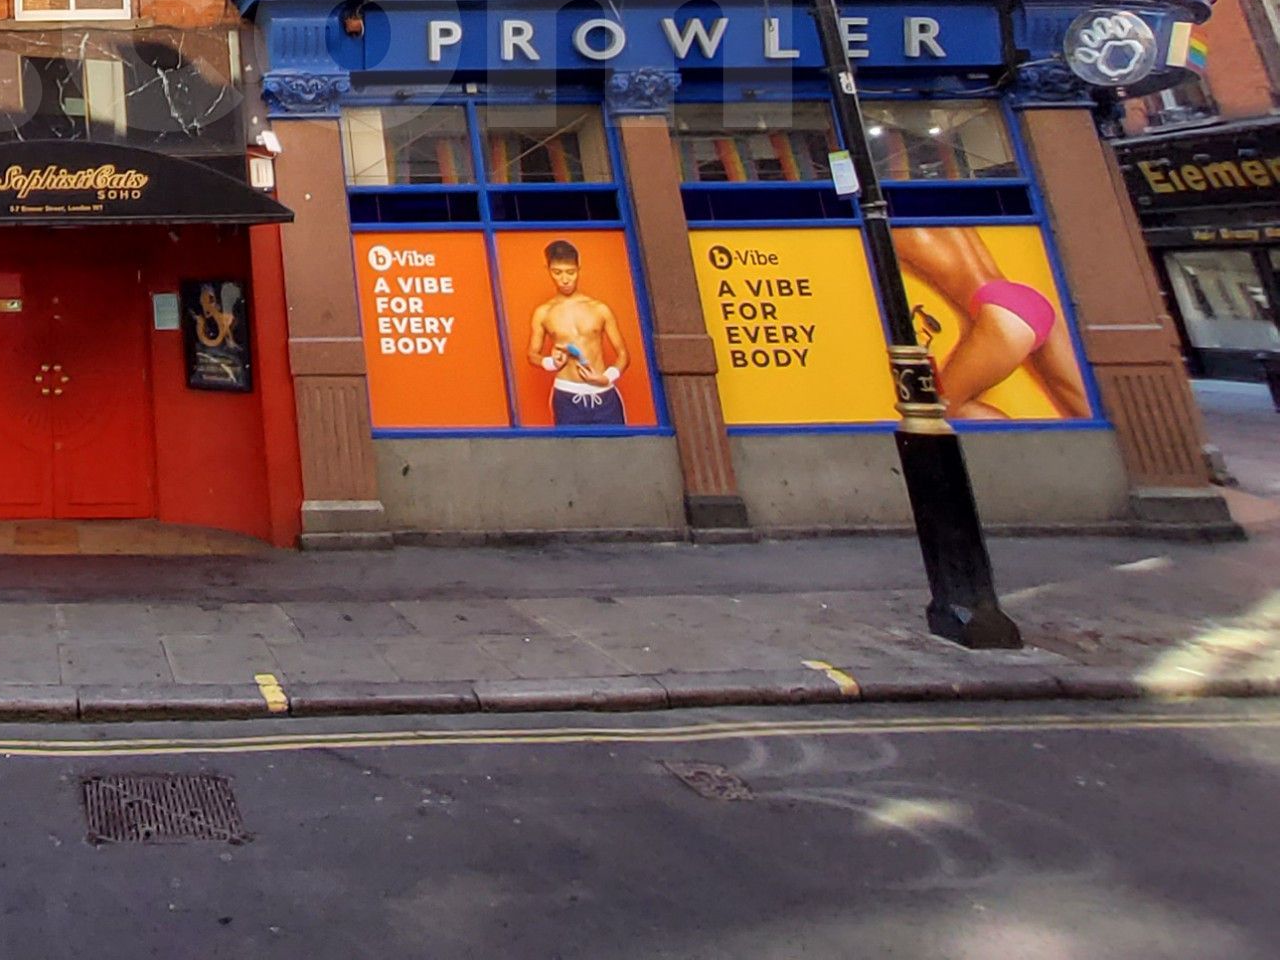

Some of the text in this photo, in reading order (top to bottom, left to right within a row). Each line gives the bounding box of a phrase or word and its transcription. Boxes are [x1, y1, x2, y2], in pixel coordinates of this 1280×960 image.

[428, 15, 947, 62] PROWLER
[96, 190, 142, 200] SOHO
[374, 276, 454, 294] A VIBE
[718, 278, 812, 297] A VIBE
[376, 296, 424, 314] FOR
[721, 302, 778, 320] FOR
[378, 316, 455, 334] EVERY
[725, 324, 816, 345] EVERY
[380, 337, 448, 354] BODY
[730, 348, 809, 369] BODY
